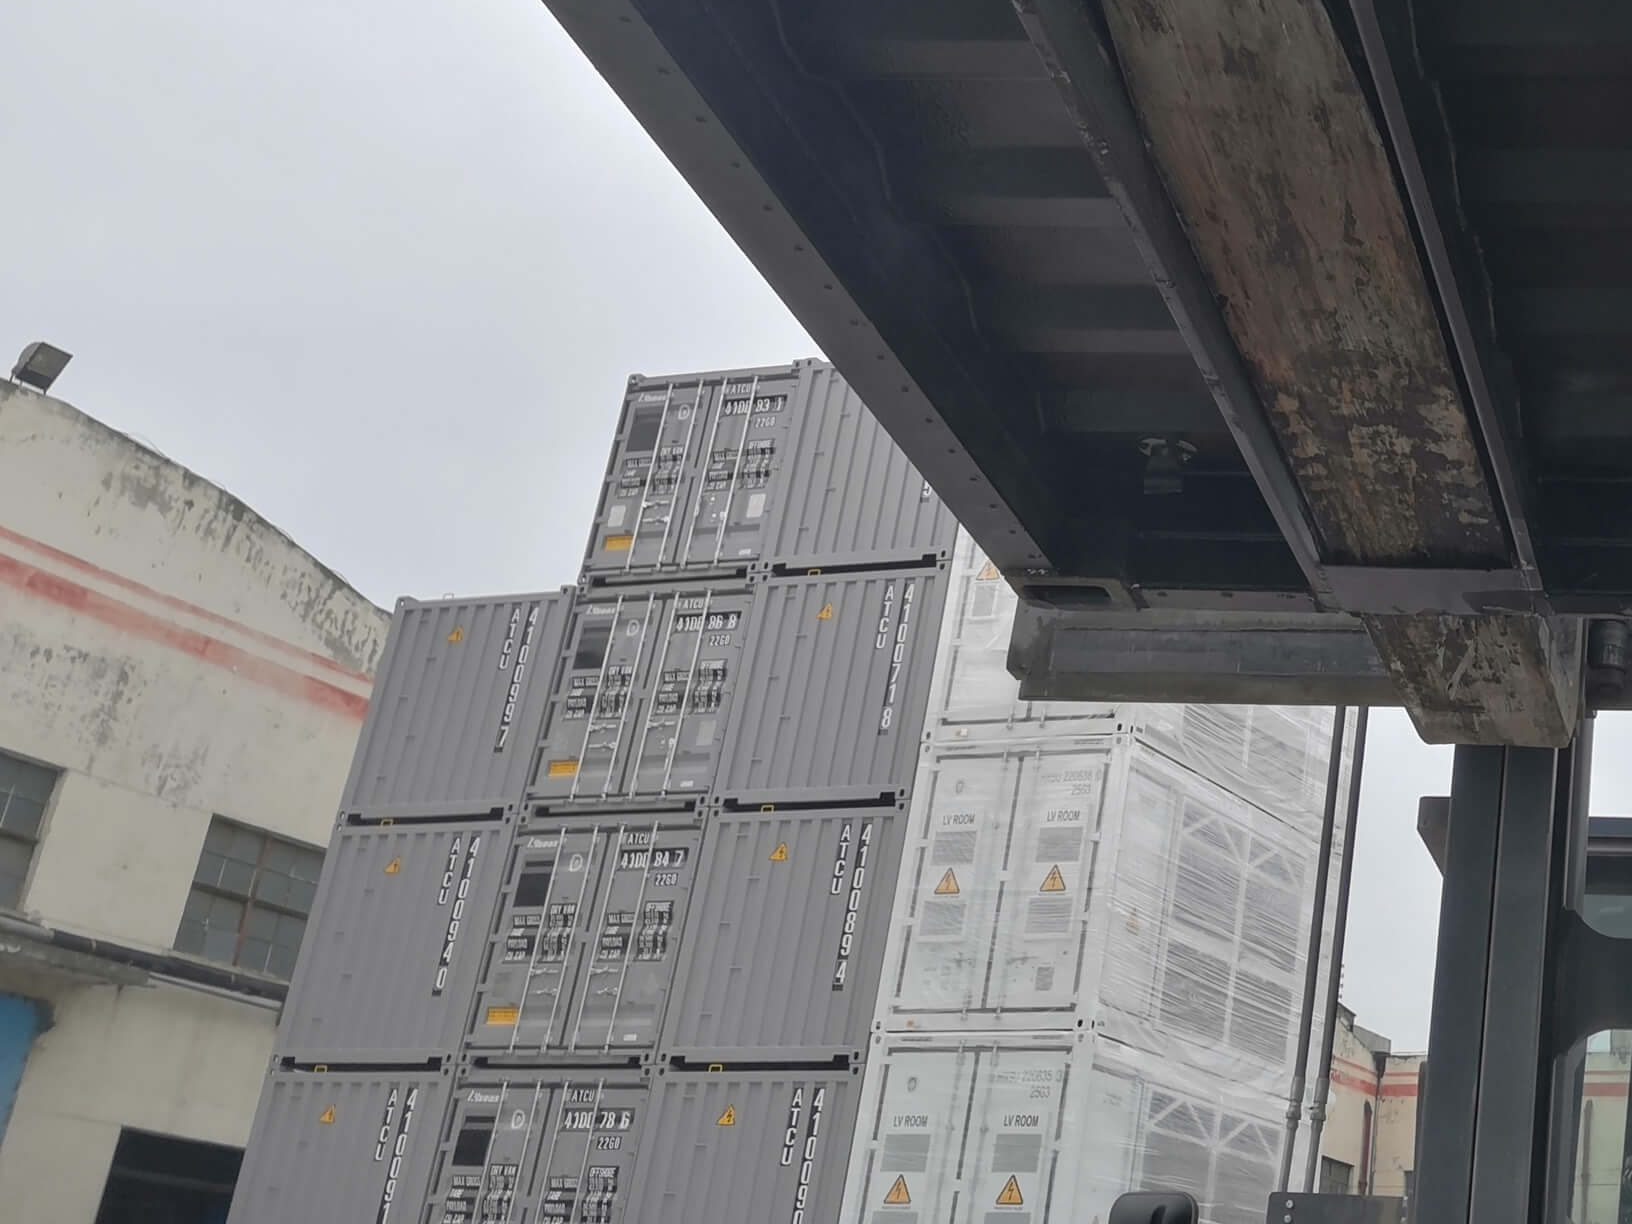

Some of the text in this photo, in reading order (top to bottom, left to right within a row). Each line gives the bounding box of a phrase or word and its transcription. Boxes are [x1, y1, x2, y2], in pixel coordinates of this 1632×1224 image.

[876, 584, 894, 649] ATCU
[499, 607, 520, 670] ATCU
[953, 813, 975, 825] ROOM
[1057, 809, 1080, 822] ROOM
[628, 832, 649, 845] ATCU
[438, 837, 461, 905] ATCU
[831, 824, 851, 894] ATCU
[571, 1089, 594, 1103] ATCU
[375, 1088, 398, 1161] ATCU
[781, 1088, 803, 1165] ATCU
[893, 1114, 929, 1127] LV ROOM
[1003, 1114, 1040, 1127] LV ROOM
